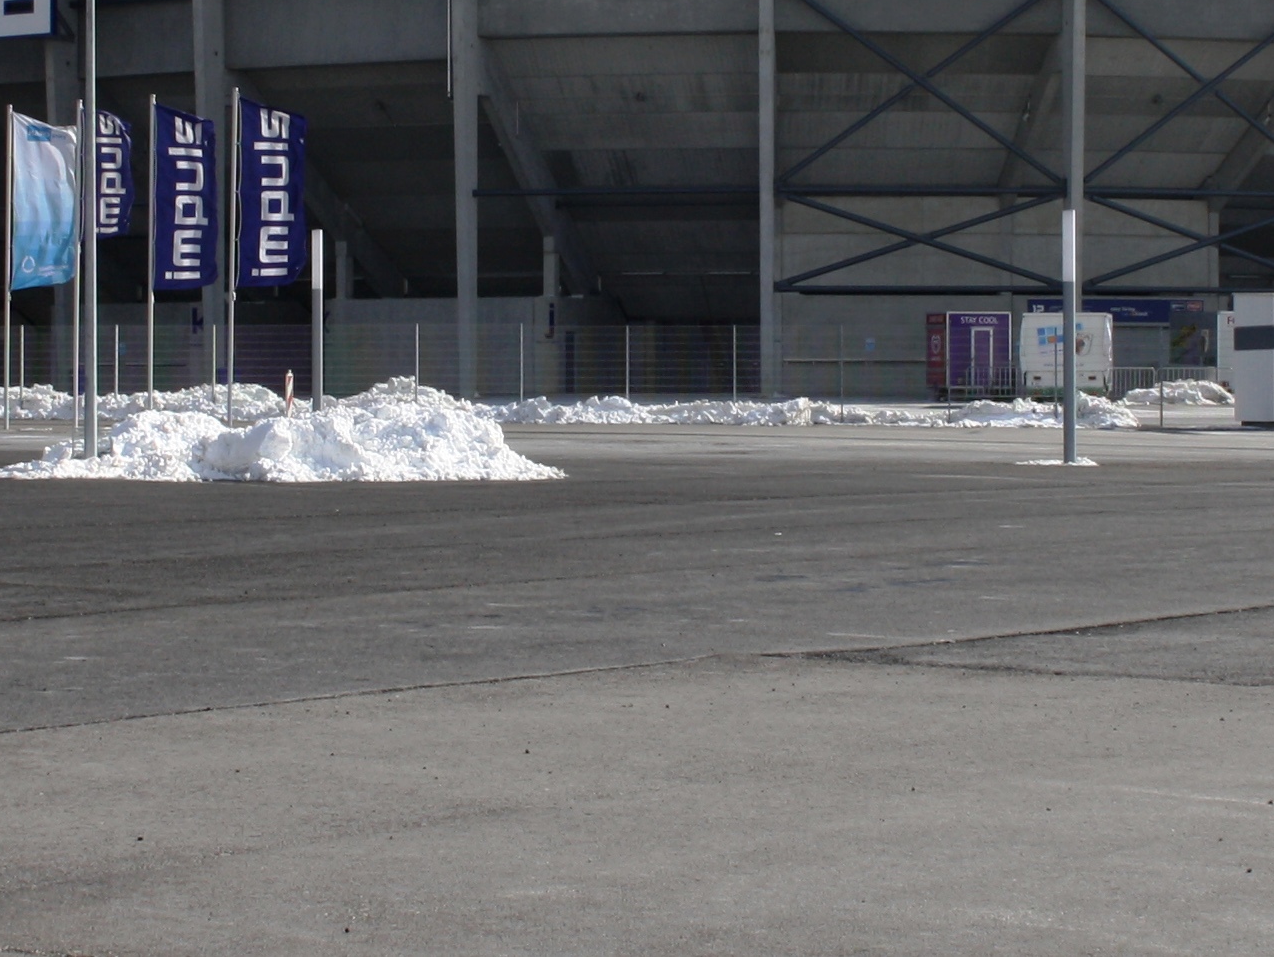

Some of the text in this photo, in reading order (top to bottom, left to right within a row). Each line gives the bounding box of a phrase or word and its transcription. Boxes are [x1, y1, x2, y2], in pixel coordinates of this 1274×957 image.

[96, 113, 126, 234] impuls
[165, 115, 209, 280] impuls
[251, 108, 295, 277] impuls
[961, 316, 999, 324] STAY COOL
